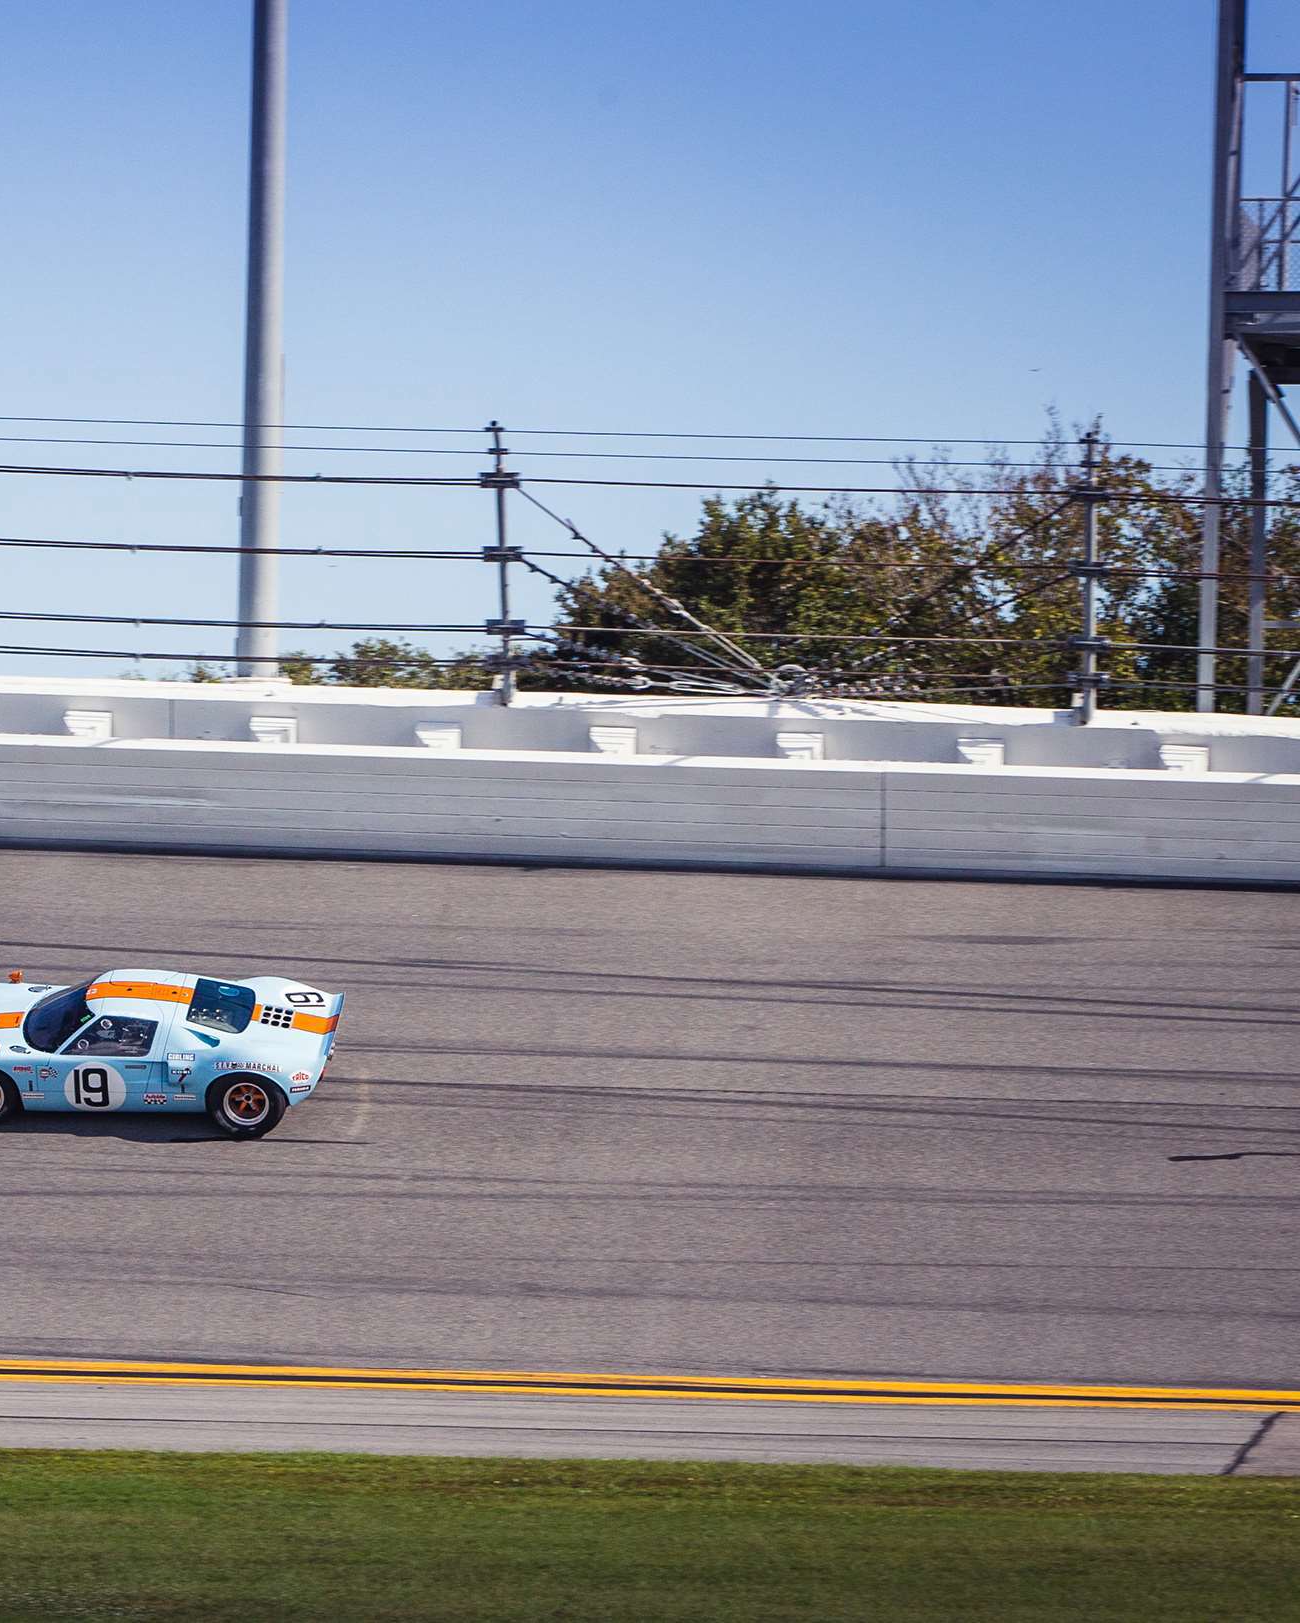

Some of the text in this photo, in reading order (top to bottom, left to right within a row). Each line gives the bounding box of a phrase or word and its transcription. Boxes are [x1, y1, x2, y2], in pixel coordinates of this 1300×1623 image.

[285, 992, 326, 1007] 19
[245, 1062, 281, 1072] MARCHAL
[73, 1067, 110, 1108] 19
